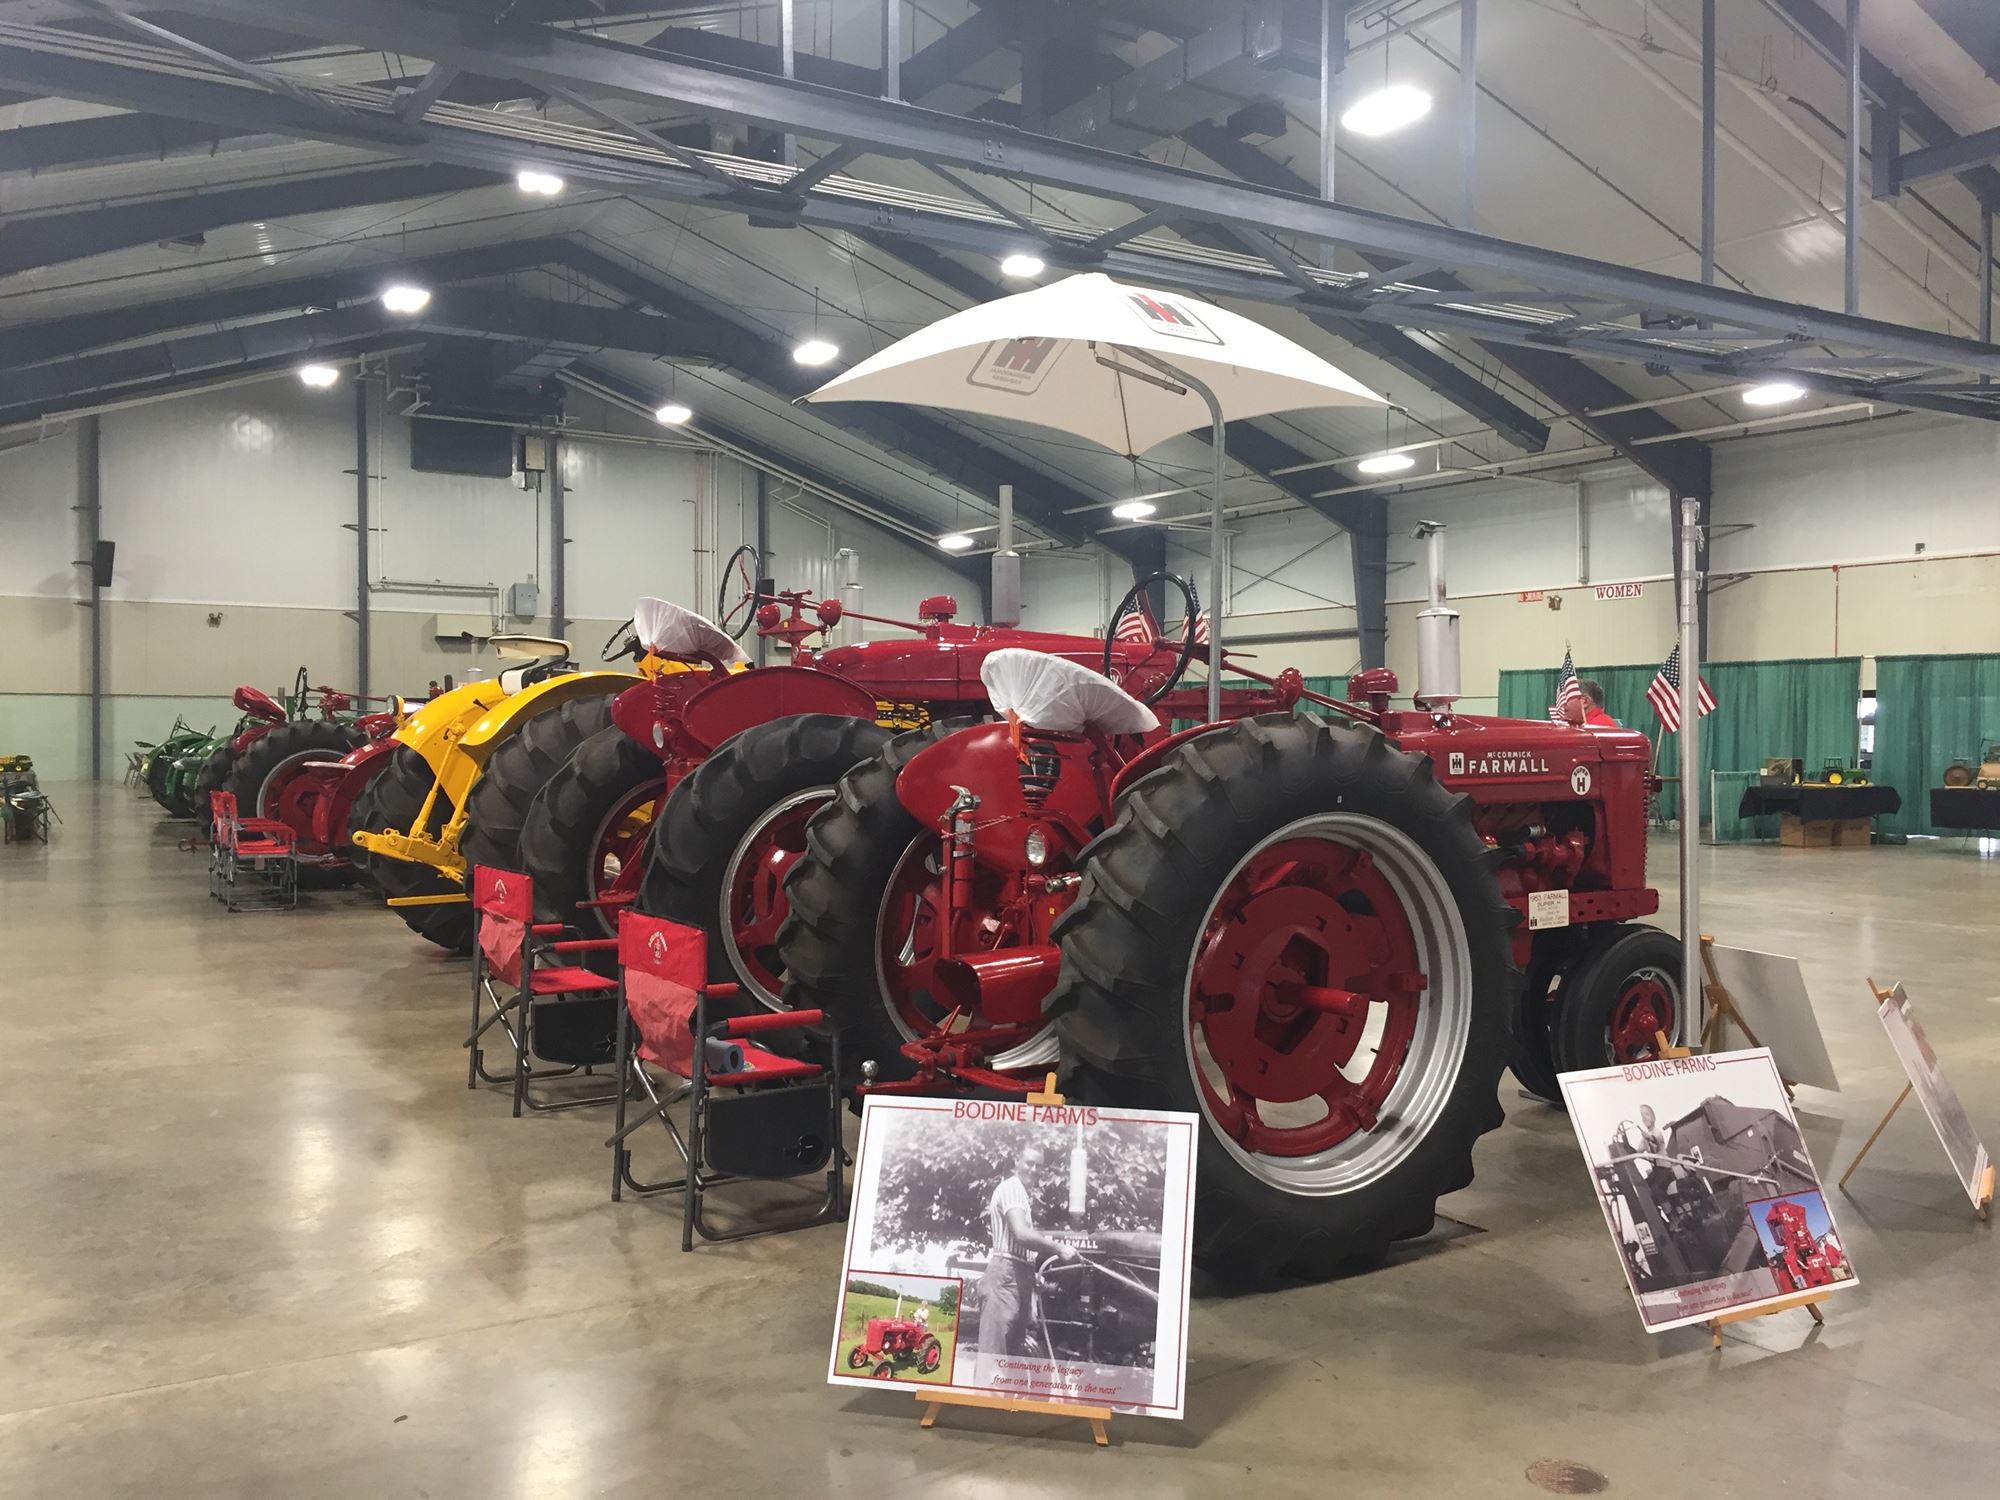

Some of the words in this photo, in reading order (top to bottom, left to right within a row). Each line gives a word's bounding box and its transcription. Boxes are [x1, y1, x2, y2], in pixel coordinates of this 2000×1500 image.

[1596, 584, 1642, 599] WOMEN
[1469, 759, 1549, 774] FARMALL
[1577, 777, 1586, 792] H
[1622, 1061, 1673, 1082] BODINE
[1673, 1056, 1716, 1074] FARMS
[954, 1101, 1027, 1122] BODINE
[1031, 1105, 1097, 1126] FARMS
[1043, 1363, 1055, 1373] the
[1058, 1364, 1084, 1376] legacy
[992, 1374, 1012, 1385] from
[1030, 1380, 1072, 1390] generation
[1074, 1383, 1083, 1392] to
[1084, 1383, 1096, 1393] the
